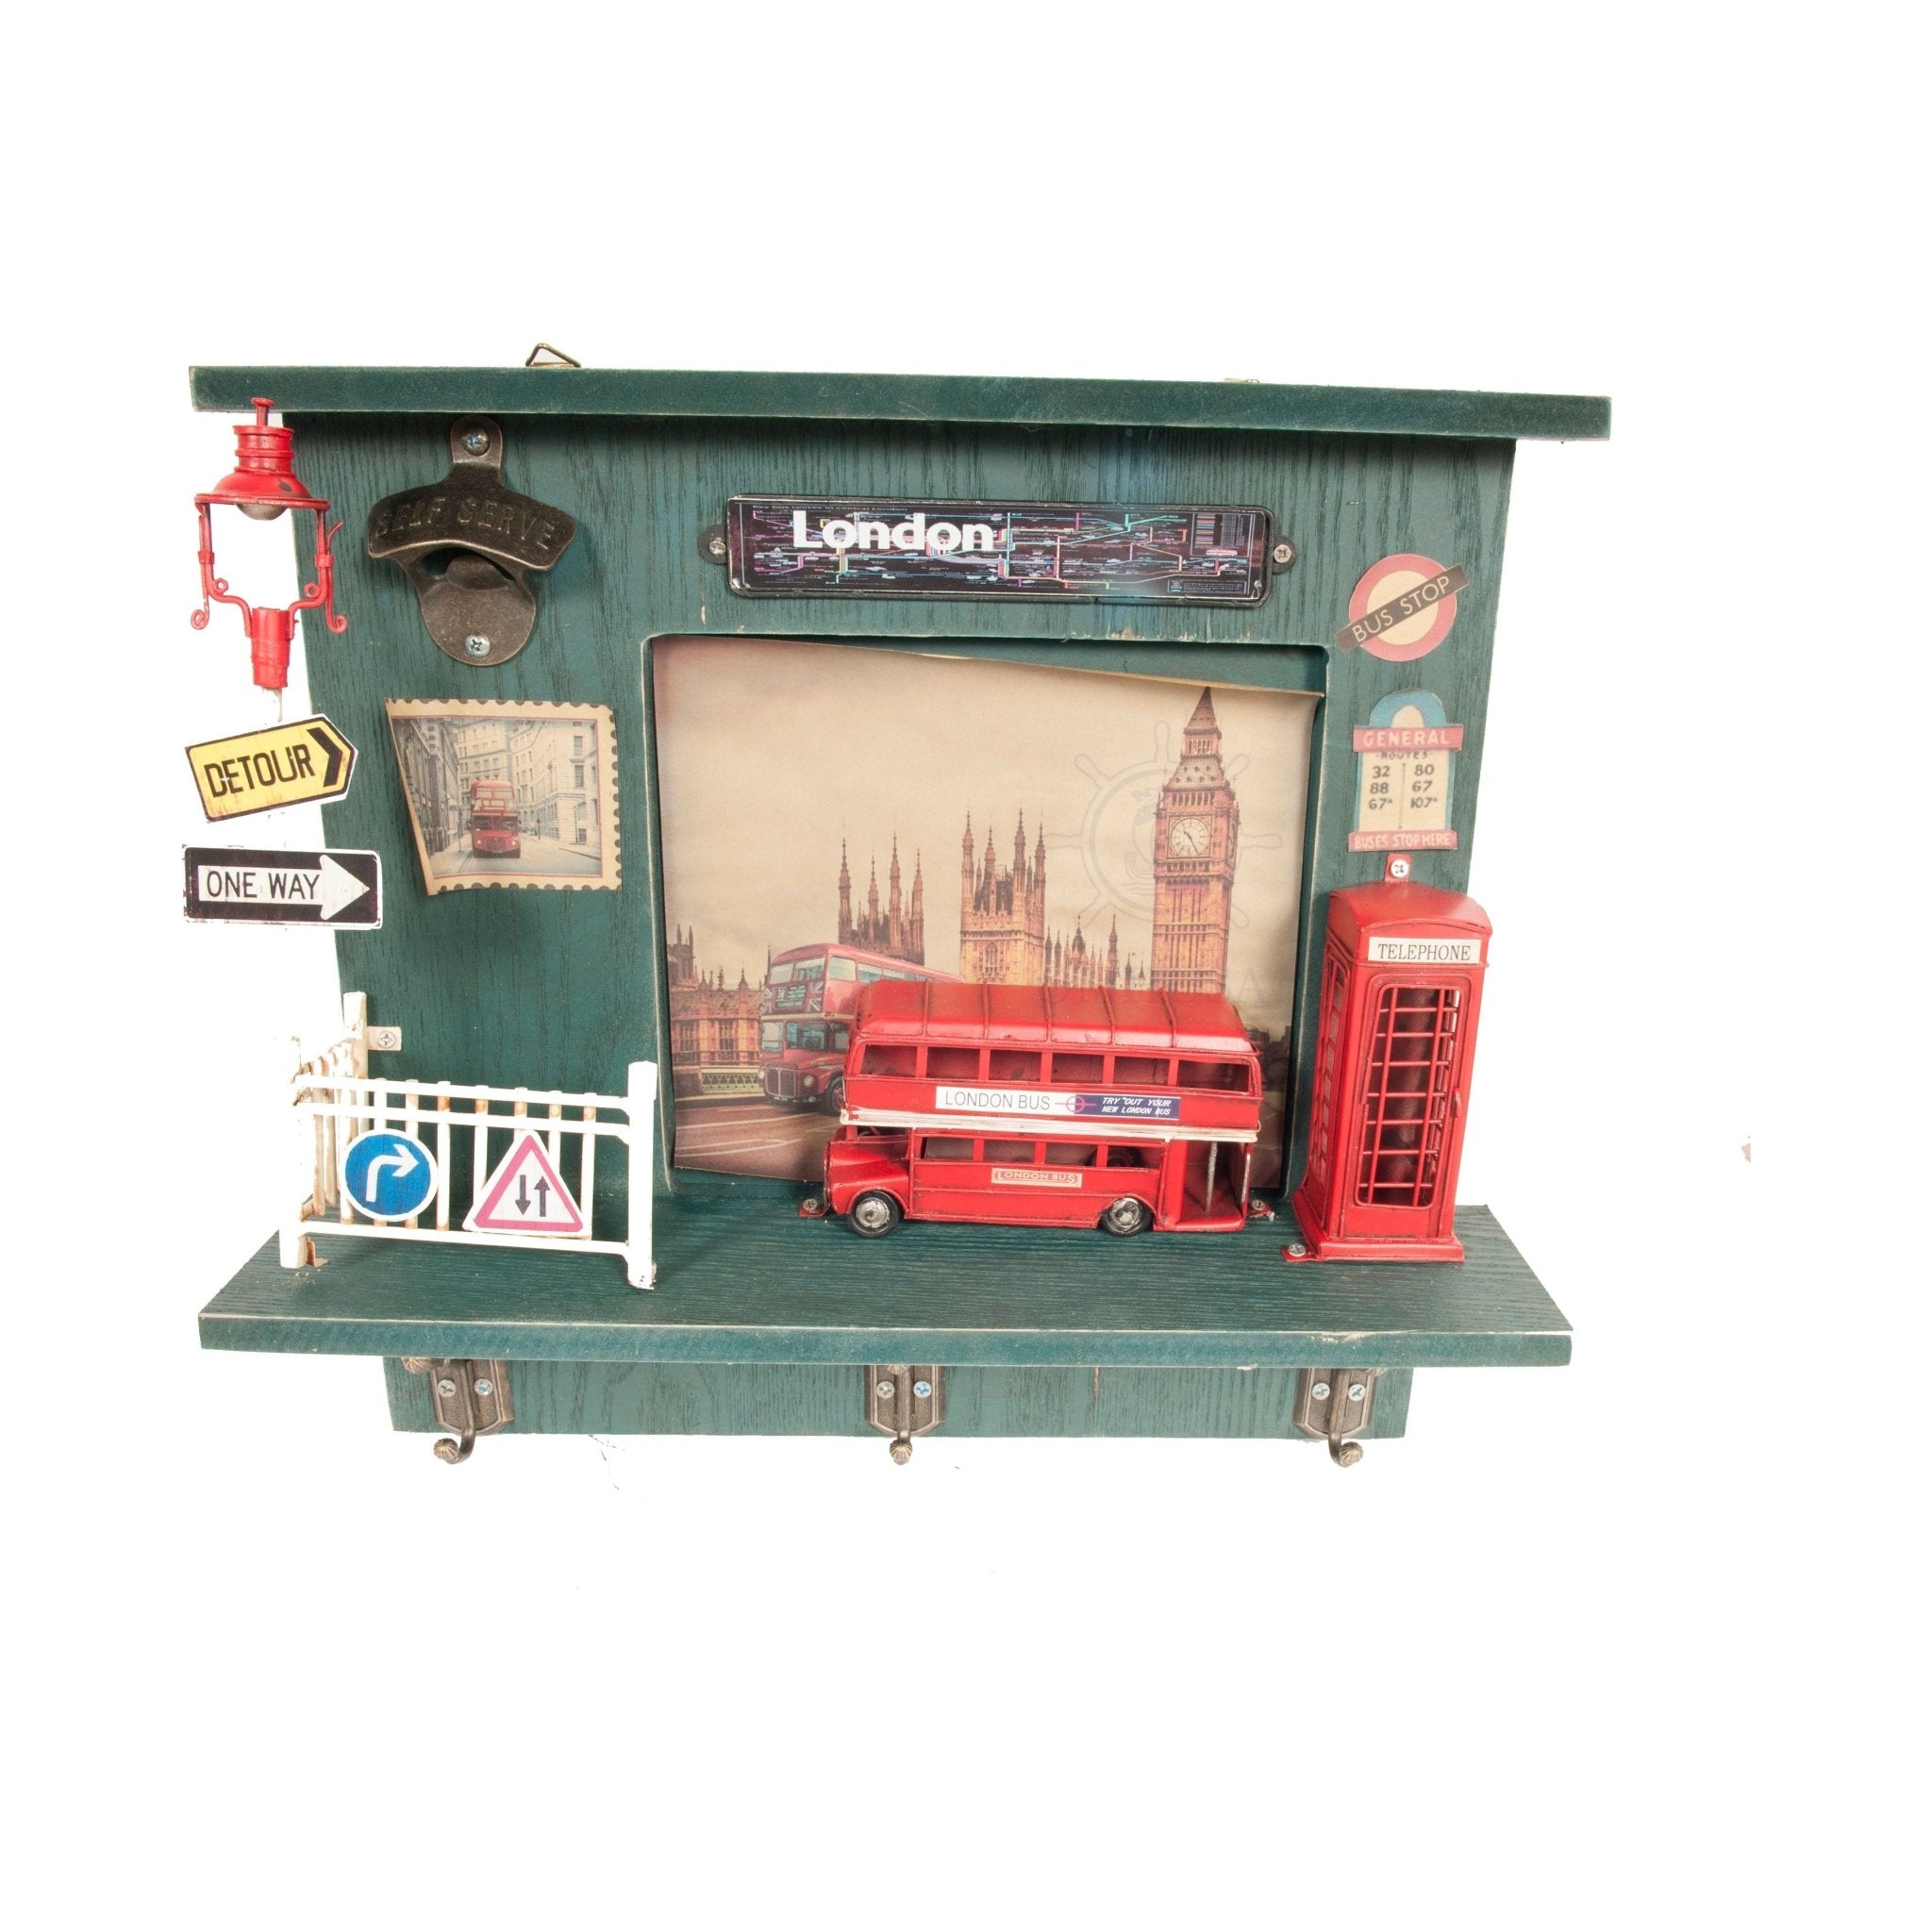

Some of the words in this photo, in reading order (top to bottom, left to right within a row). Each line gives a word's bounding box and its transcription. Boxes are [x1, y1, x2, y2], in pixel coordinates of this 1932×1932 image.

[375, 497, 446, 538] SELF
[457, 499, 559, 550] SERVE
[793, 510, 993, 551] London
[1352, 609, 1393, 642] BUS
[1400, 575, 1450, 615] STOP
[1362, 729, 1450, 747] GENERAL
[204, 743, 316, 798] DETOUR
[1373, 765, 1391, 779] 32
[1414, 763, 1435, 777] 80
[1370, 782, 1390, 794] 88
[1411, 780, 1433, 792] 67
[1354, 834, 1390, 850] BUSES
[1391, 833, 1420, 848] STOP
[1421, 832, 1451, 847] HERE
[207, 870, 258, 898] ONE
[268, 872, 320, 900] WAY
[1377, 942, 1472, 961] TELEPHONE
[944, 1090, 1013, 1109] LONDON
[1018, 1093, 1051, 1110] BUS
[1102, 1096, 1121, 1105] TRY
[1147, 1098, 1172, 1108] YOUR
[1101, 1105, 1120, 1113] NEW
[1121, 1106, 1153, 1115] LONDON
[1154, 1108, 1172, 1116] BUS
[996, 1170, 1049, 1181] LONDON
[1052, 1173, 1076, 1184] BUS
